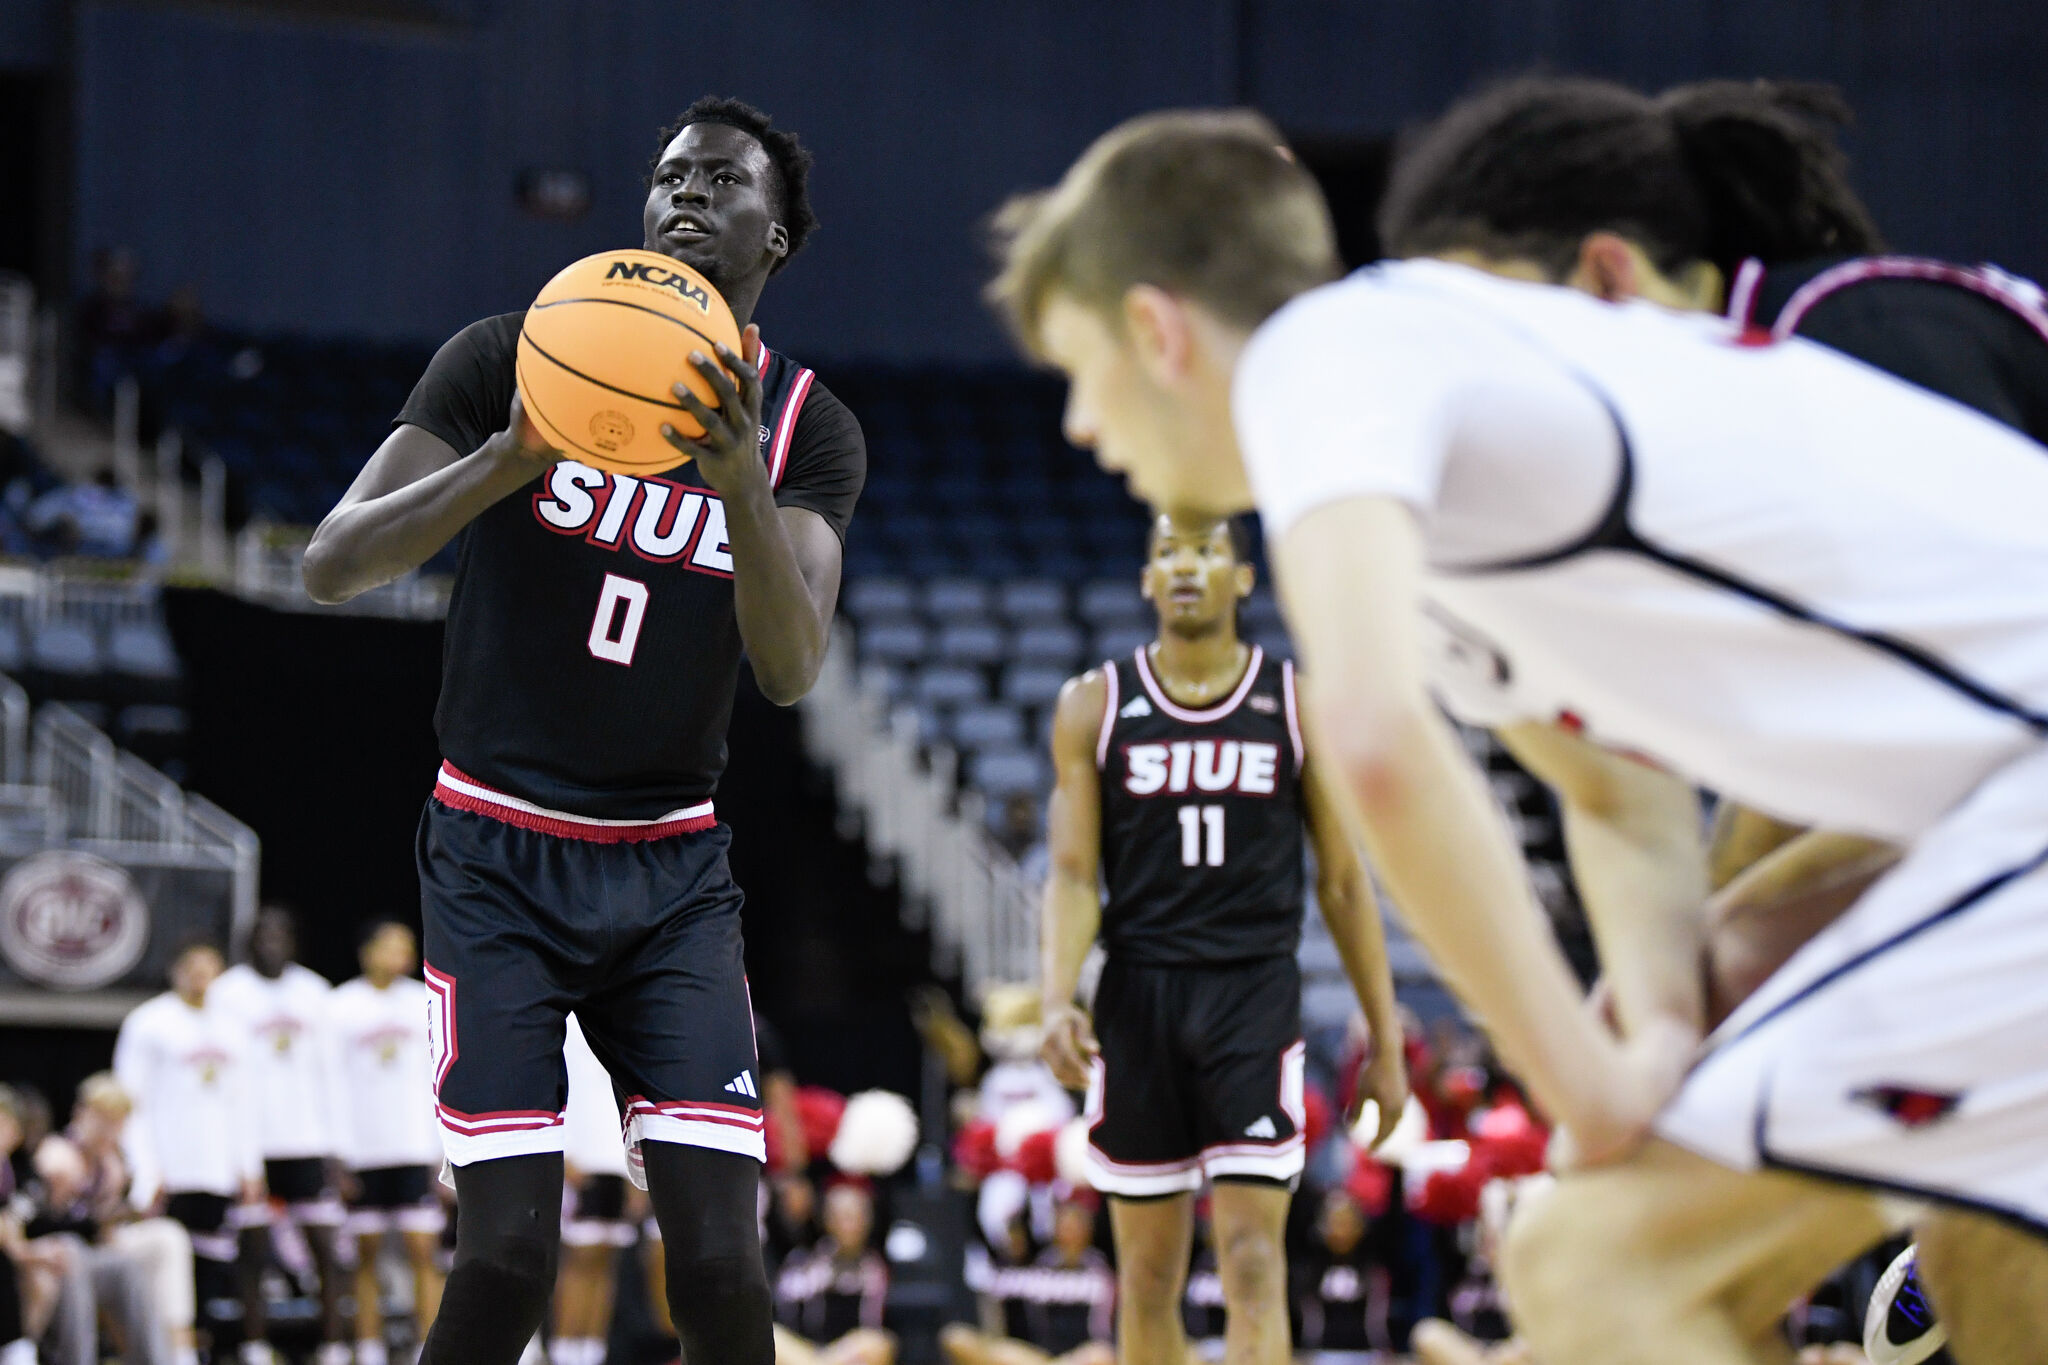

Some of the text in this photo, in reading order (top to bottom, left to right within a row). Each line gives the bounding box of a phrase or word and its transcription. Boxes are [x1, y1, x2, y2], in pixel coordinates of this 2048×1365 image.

[604, 261, 709, 312] NCAA
[533, 460, 735, 579] SIUE
[588, 571, 649, 667] 0
[1123, 739, 1281, 797] SIUE
[1178, 804, 1225, 867] 11
